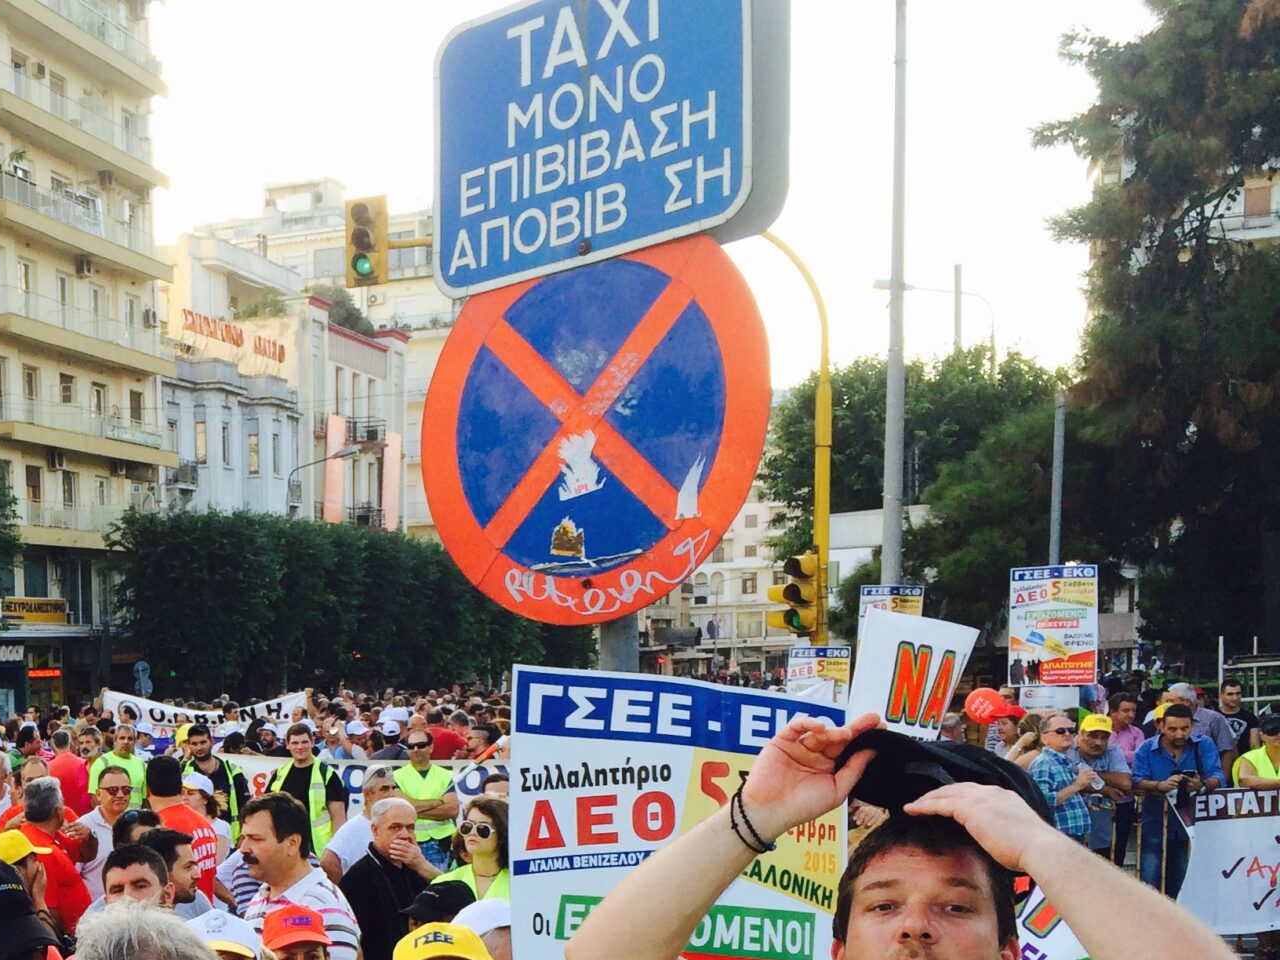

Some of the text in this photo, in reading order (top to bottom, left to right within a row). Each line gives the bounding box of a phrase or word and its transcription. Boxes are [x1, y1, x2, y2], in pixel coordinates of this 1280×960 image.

[505, 0, 660, 88] ΤΑΧΙ
[507, 53, 666, 150] ΜΟΝΟ
[459, 90, 717, 218] ΕΠΙΒΙΒΑΣΗ
[1014, 568, 1051, 580] ΓΣΕΕ
[1063, 566, 1095, 577] ΕΚΘ
[863, 587, 892, 596] ΓΣΕΕ
[899, 587, 922, 596] ΕΚΘ
[1015, 589, 1048, 604] ΔΕΘ
[1051, 580, 1061, 597] 5
[890, 597, 899, 609] 5
[791, 649, 818, 658] ΓΣΕΕ
[826, 649, 849, 658] ΕΚΘ
[790, 666, 813, 677] ΔΕΘ
[816, 660, 825, 673] 5
[527, 682, 693, 737] ΓΣΕΕ
[738, 703, 837, 748] ΕΚ
[521, 757, 672, 793] Συλλαλητήριο
[525, 790, 676, 851] ΔΕΘ
[528, 851, 645, 873] ΑΓΑΛΜΑ ΒΕΝΙΖΕΛΟΥ
[803, 850, 837, 874] 2015
[283, 916, 313, 928] ΓΣΕΕ
[532, 912, 551, 937] Οι
[413, 931, 455, 949] ΓΣΕΕ
